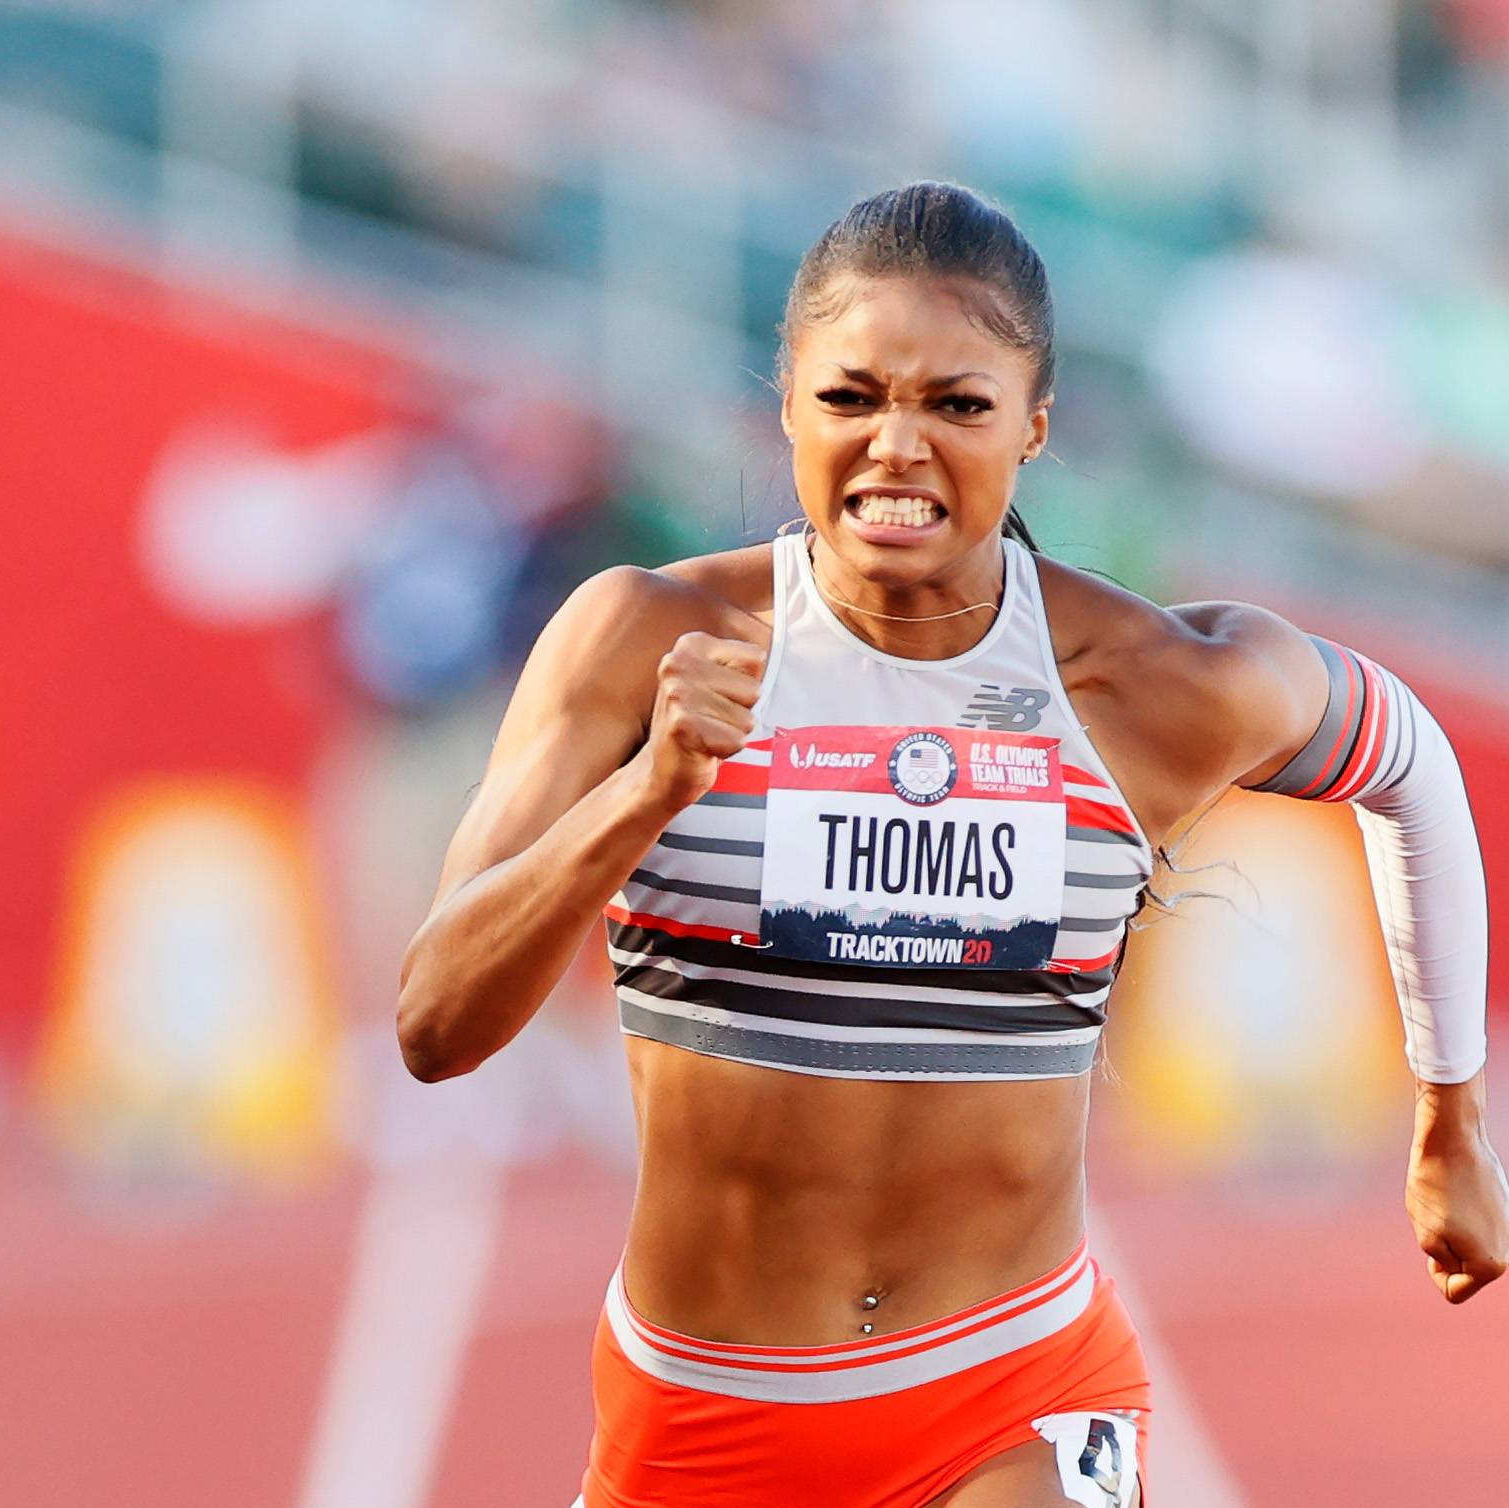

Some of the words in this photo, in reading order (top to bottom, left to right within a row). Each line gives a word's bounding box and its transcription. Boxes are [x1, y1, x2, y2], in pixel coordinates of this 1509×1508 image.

[815, 752, 877, 768] USATF
[970, 743, 993, 763] U.S.
[995, 745, 1048, 768] OLYMPIC
[970, 763, 1006, 783] TEAM
[1005, 766, 1050, 788] TRIALS
[819, 814, 1016, 901] THOMAS
